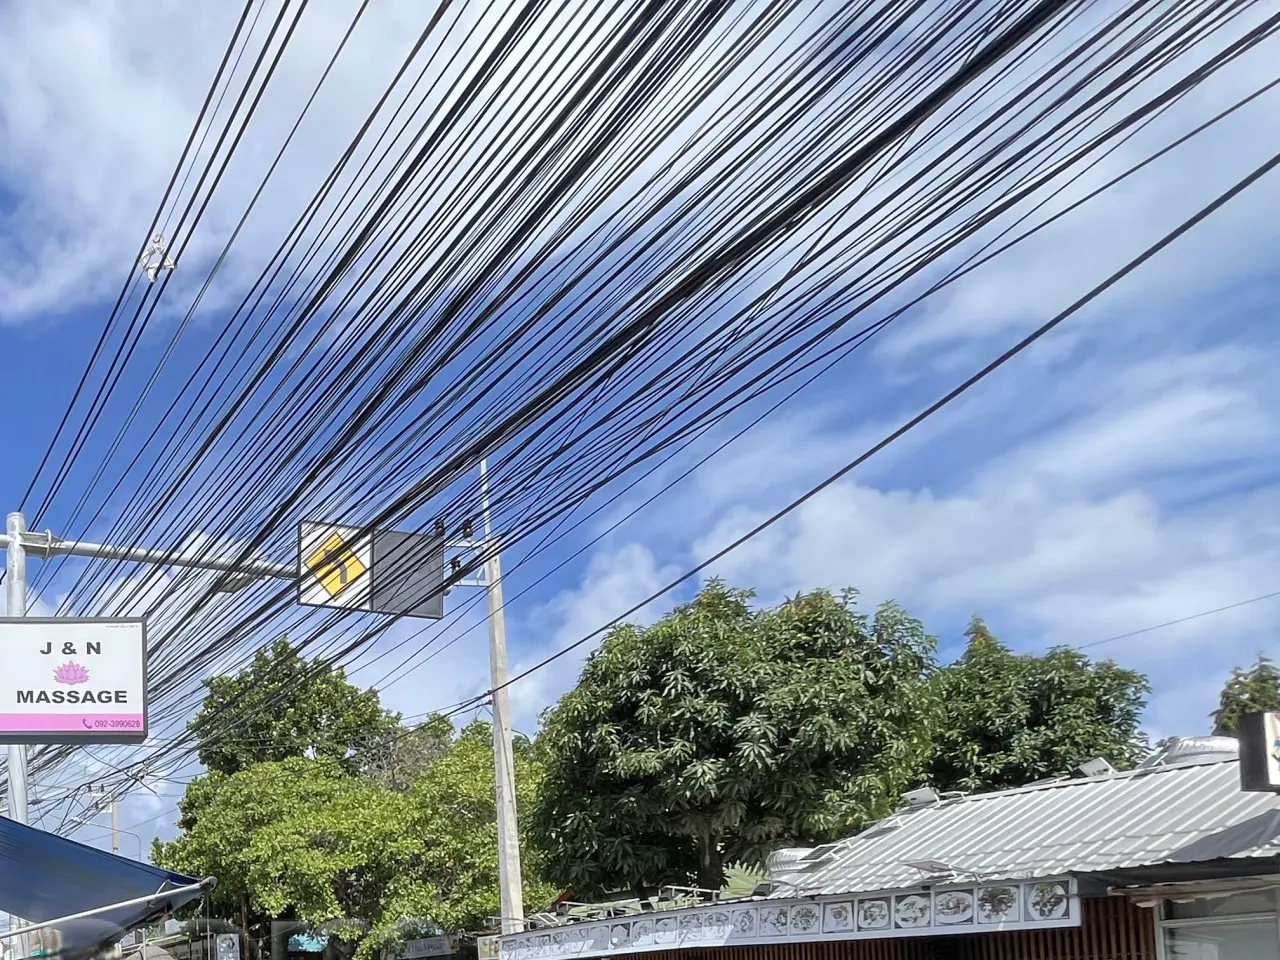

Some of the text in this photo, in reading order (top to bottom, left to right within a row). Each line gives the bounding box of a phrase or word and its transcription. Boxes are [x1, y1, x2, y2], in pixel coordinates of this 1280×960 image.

[40, 642, 101, 655] J & N
[16, 690, 128, 704] MASSAGE
[94, 719, 141, 728] 092-3990628
